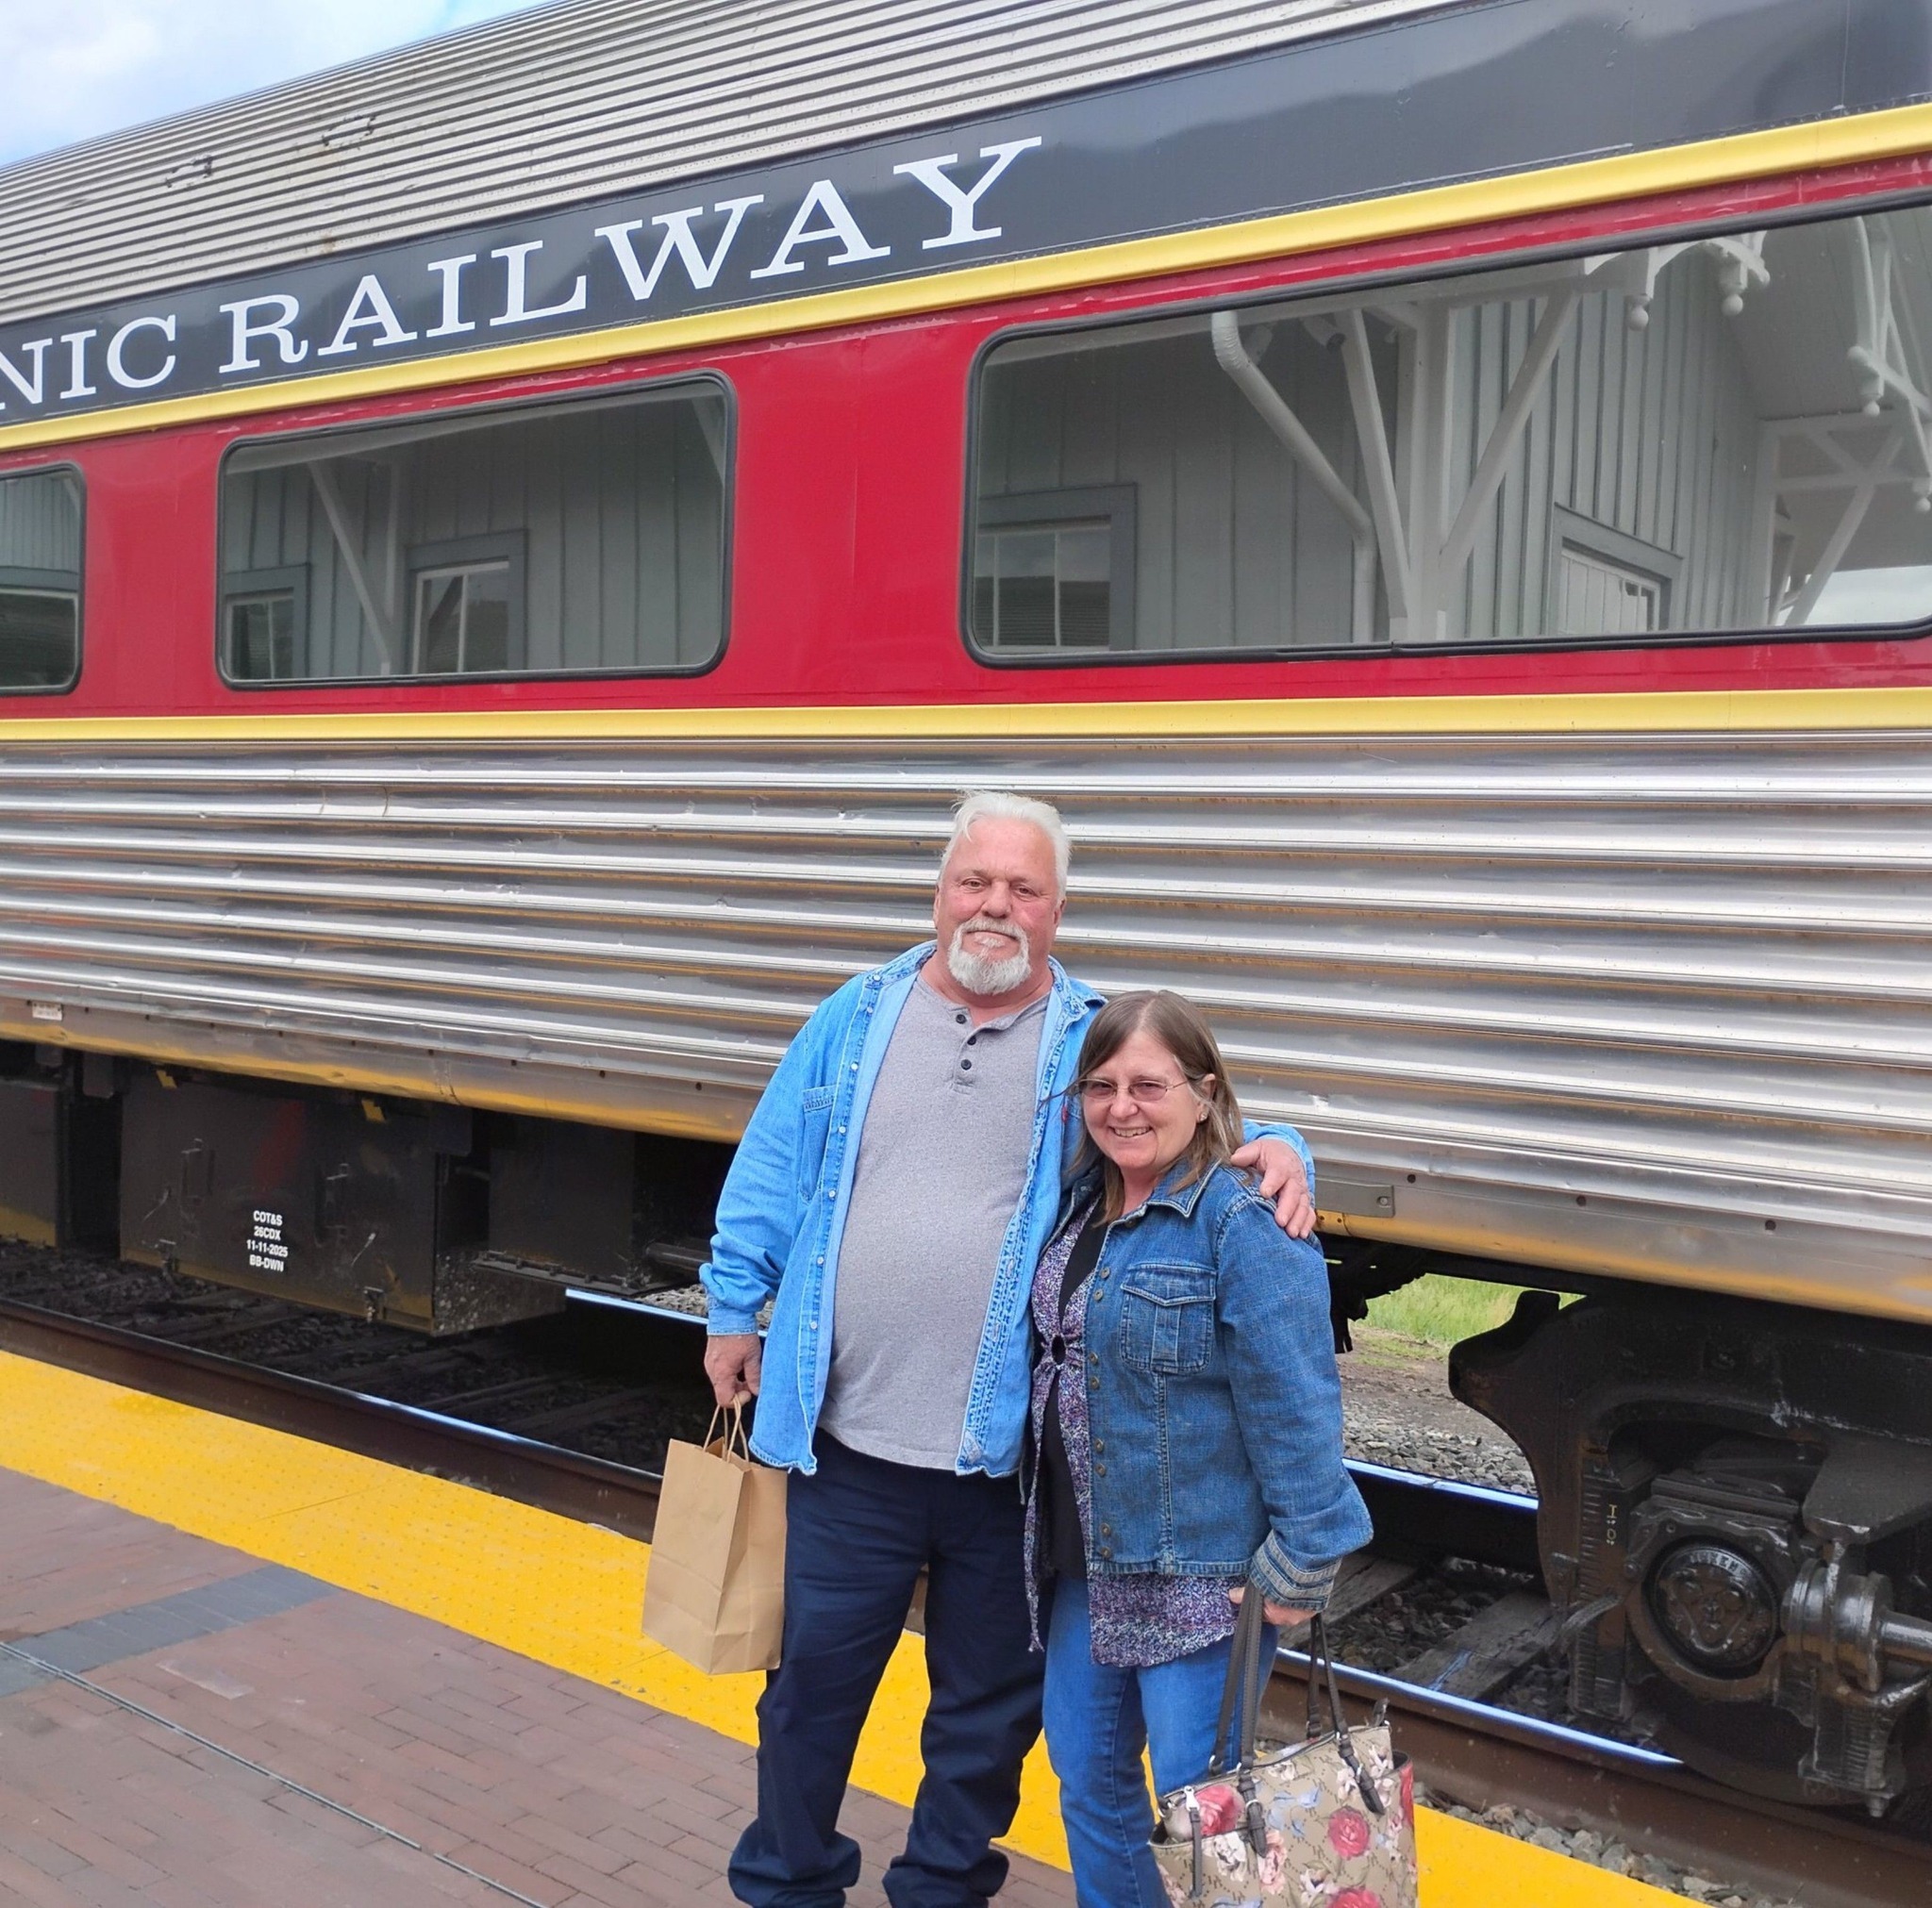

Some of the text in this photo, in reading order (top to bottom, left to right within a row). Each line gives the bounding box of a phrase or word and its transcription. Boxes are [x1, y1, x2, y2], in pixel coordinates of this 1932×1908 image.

[0, 136, 1042, 410] NIC RAILWAY
[253, 1210, 283, 1226] COT&S
[246, 1239, 289, 1257] 11-11-2025
